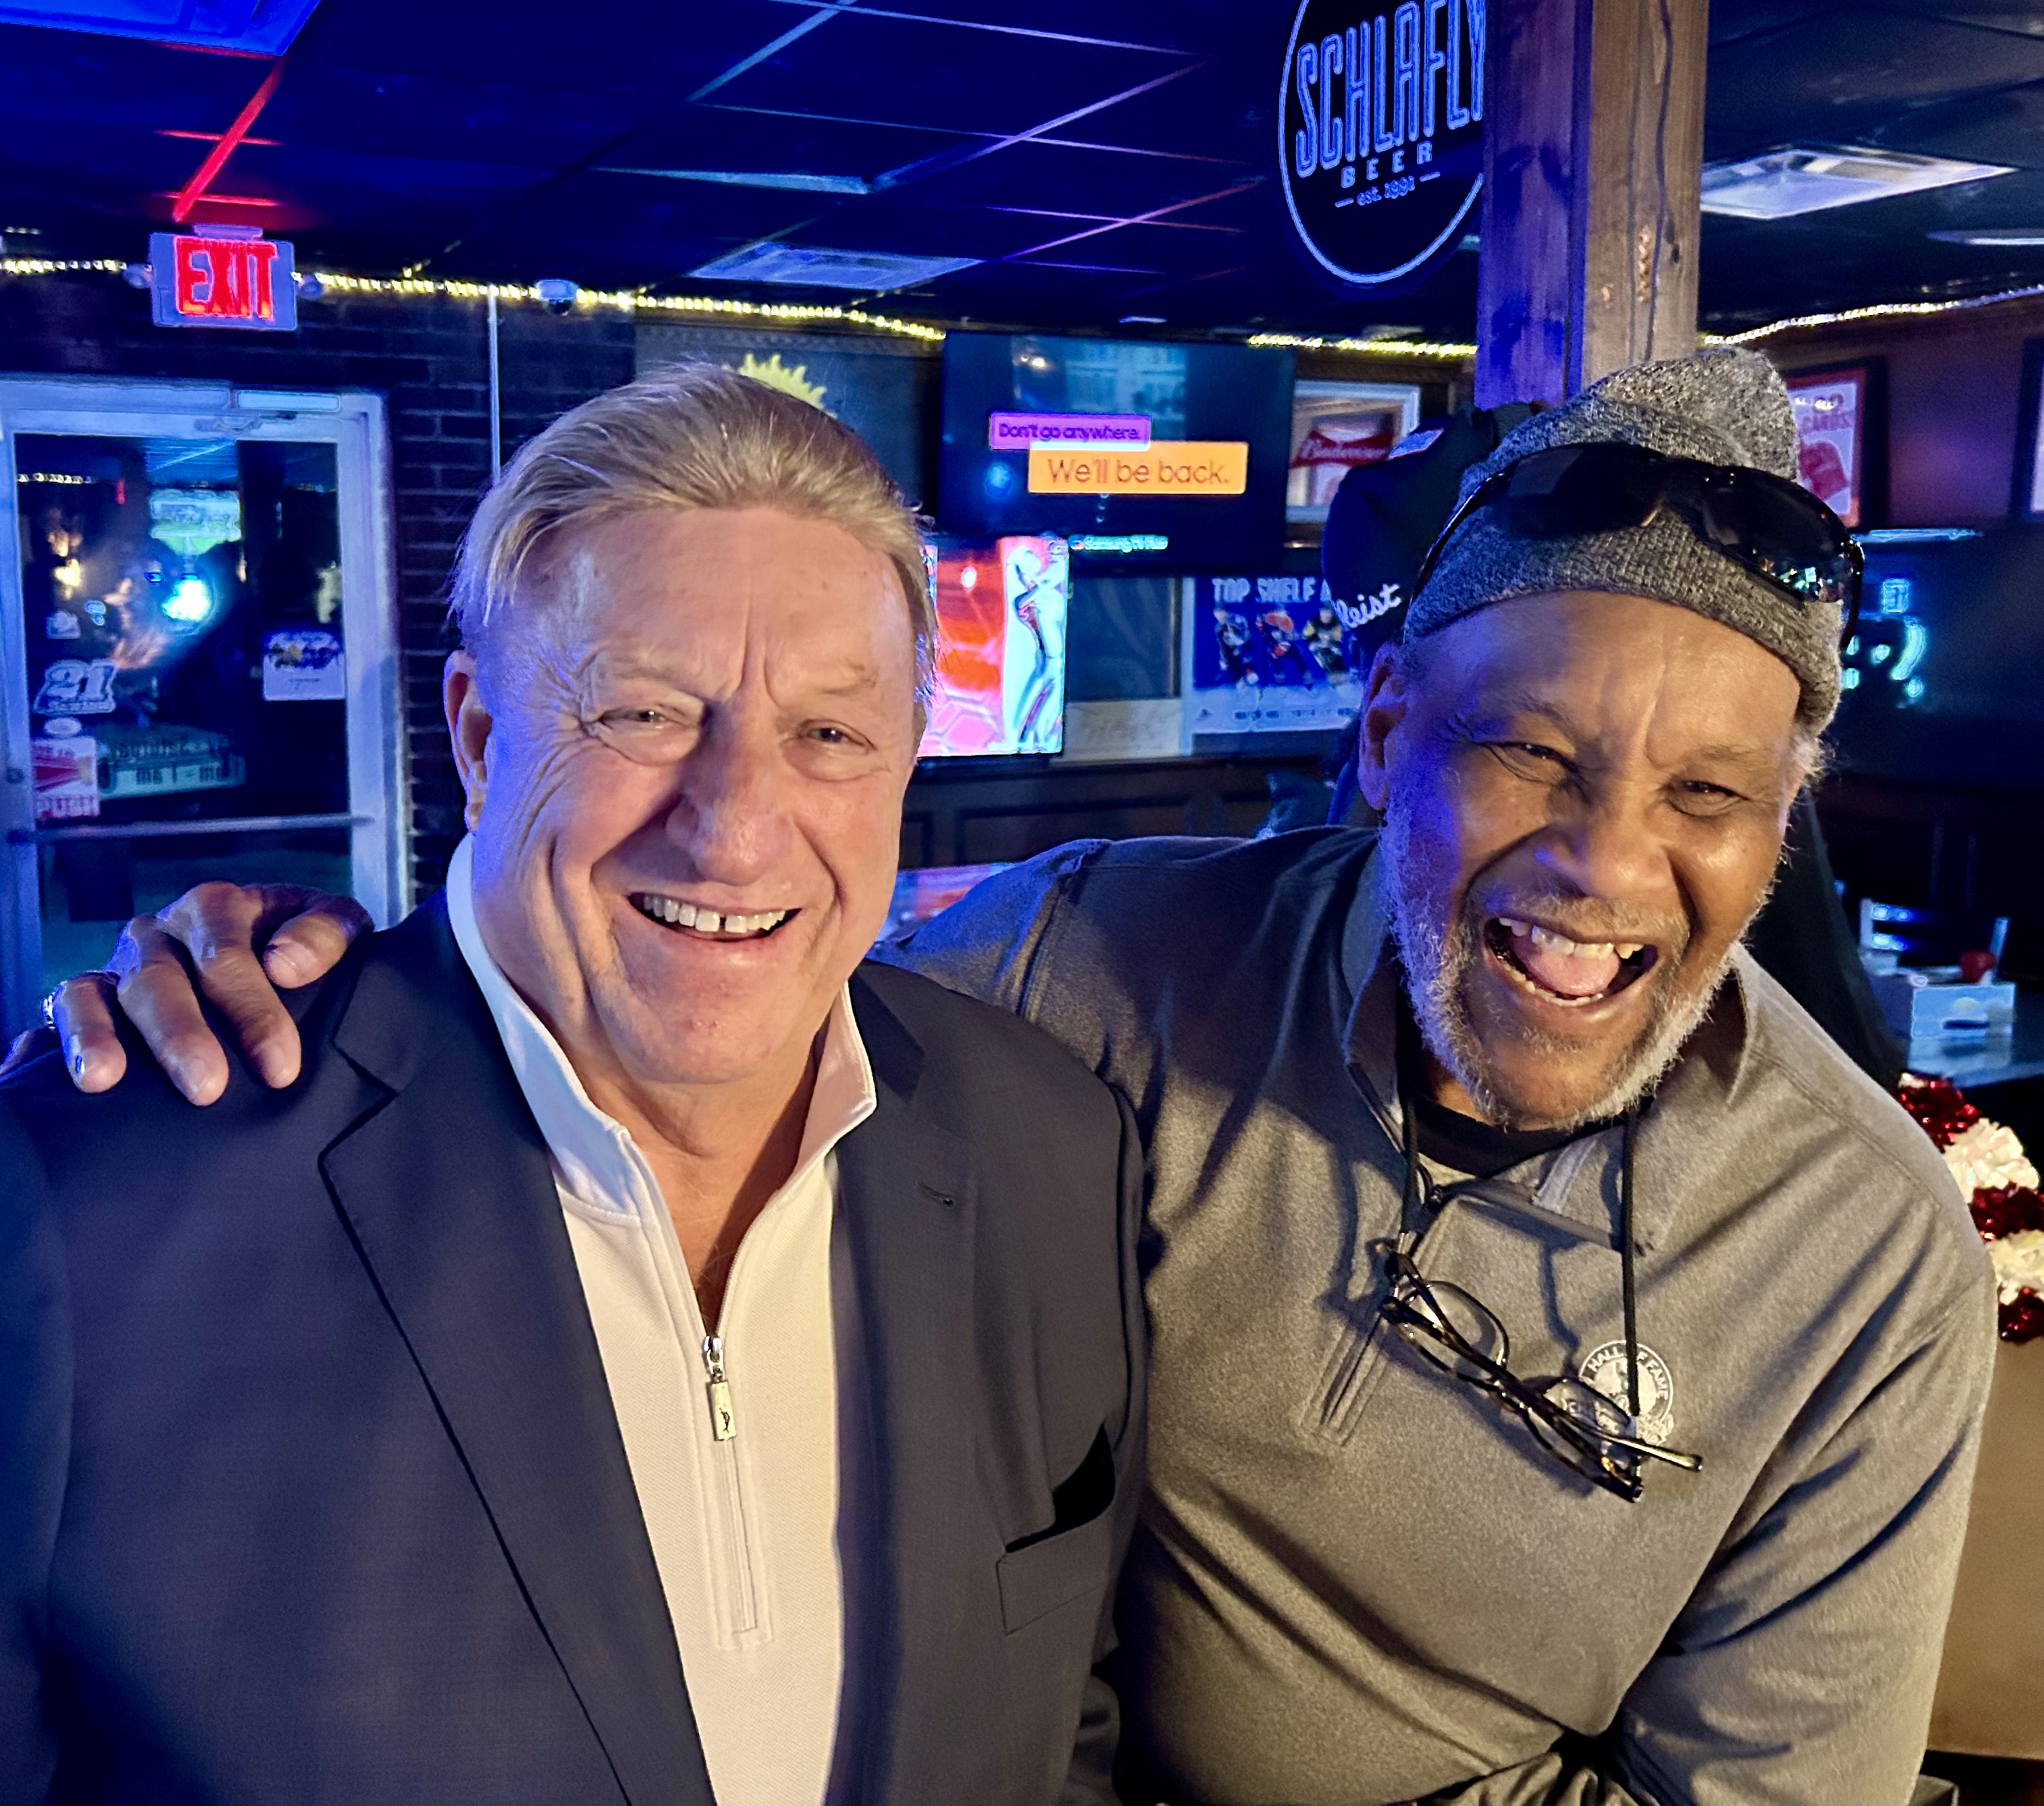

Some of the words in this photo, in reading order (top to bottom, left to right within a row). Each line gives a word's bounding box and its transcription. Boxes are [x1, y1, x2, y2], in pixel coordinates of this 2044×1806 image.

[1341, 141, 1432, 189] BEER
[173, 235, 278, 320] EXIT
[1040, 426, 1062, 442] go
[1047, 458, 1111, 484] We'll
[1116, 459, 1150, 484] be
[1158, 459, 1231, 484] back.
[1212, 577, 1252, 604] TOP
[46, 664, 113, 703] 21
[1587, 1346, 1624, 1373] HALL
[1644, 1361, 1669, 1401] FAME
